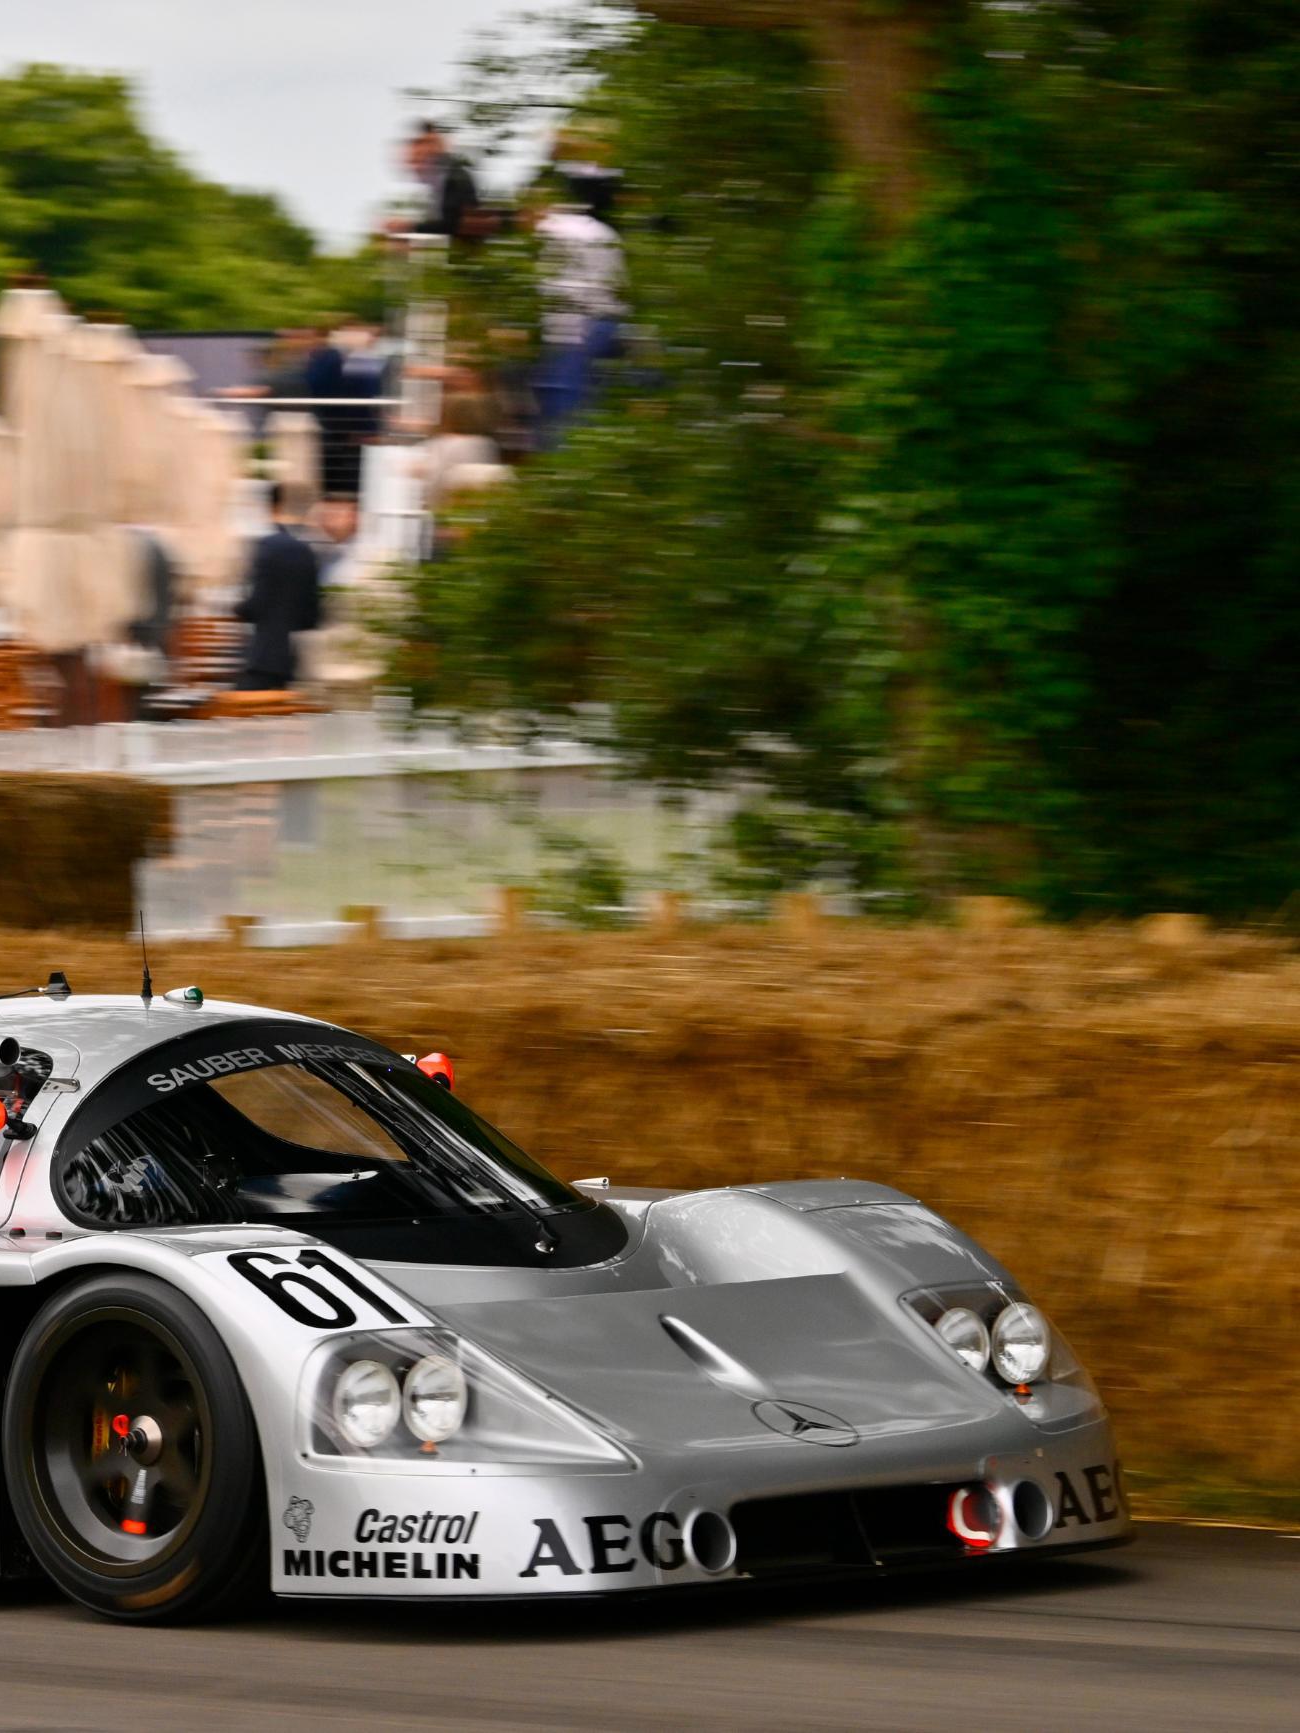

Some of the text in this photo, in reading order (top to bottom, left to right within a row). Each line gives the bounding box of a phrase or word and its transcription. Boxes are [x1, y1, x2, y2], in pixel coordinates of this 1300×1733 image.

[146, 1048, 275, 1093] SAUBER
[227, 1250, 409, 1329] 61
[1053, 1458, 1125, 1529] AE
[355, 1507, 481, 1544] Castrol
[519, 1511, 687, 1577] AEG
[283, 1549, 481, 1579] MICHELIN
